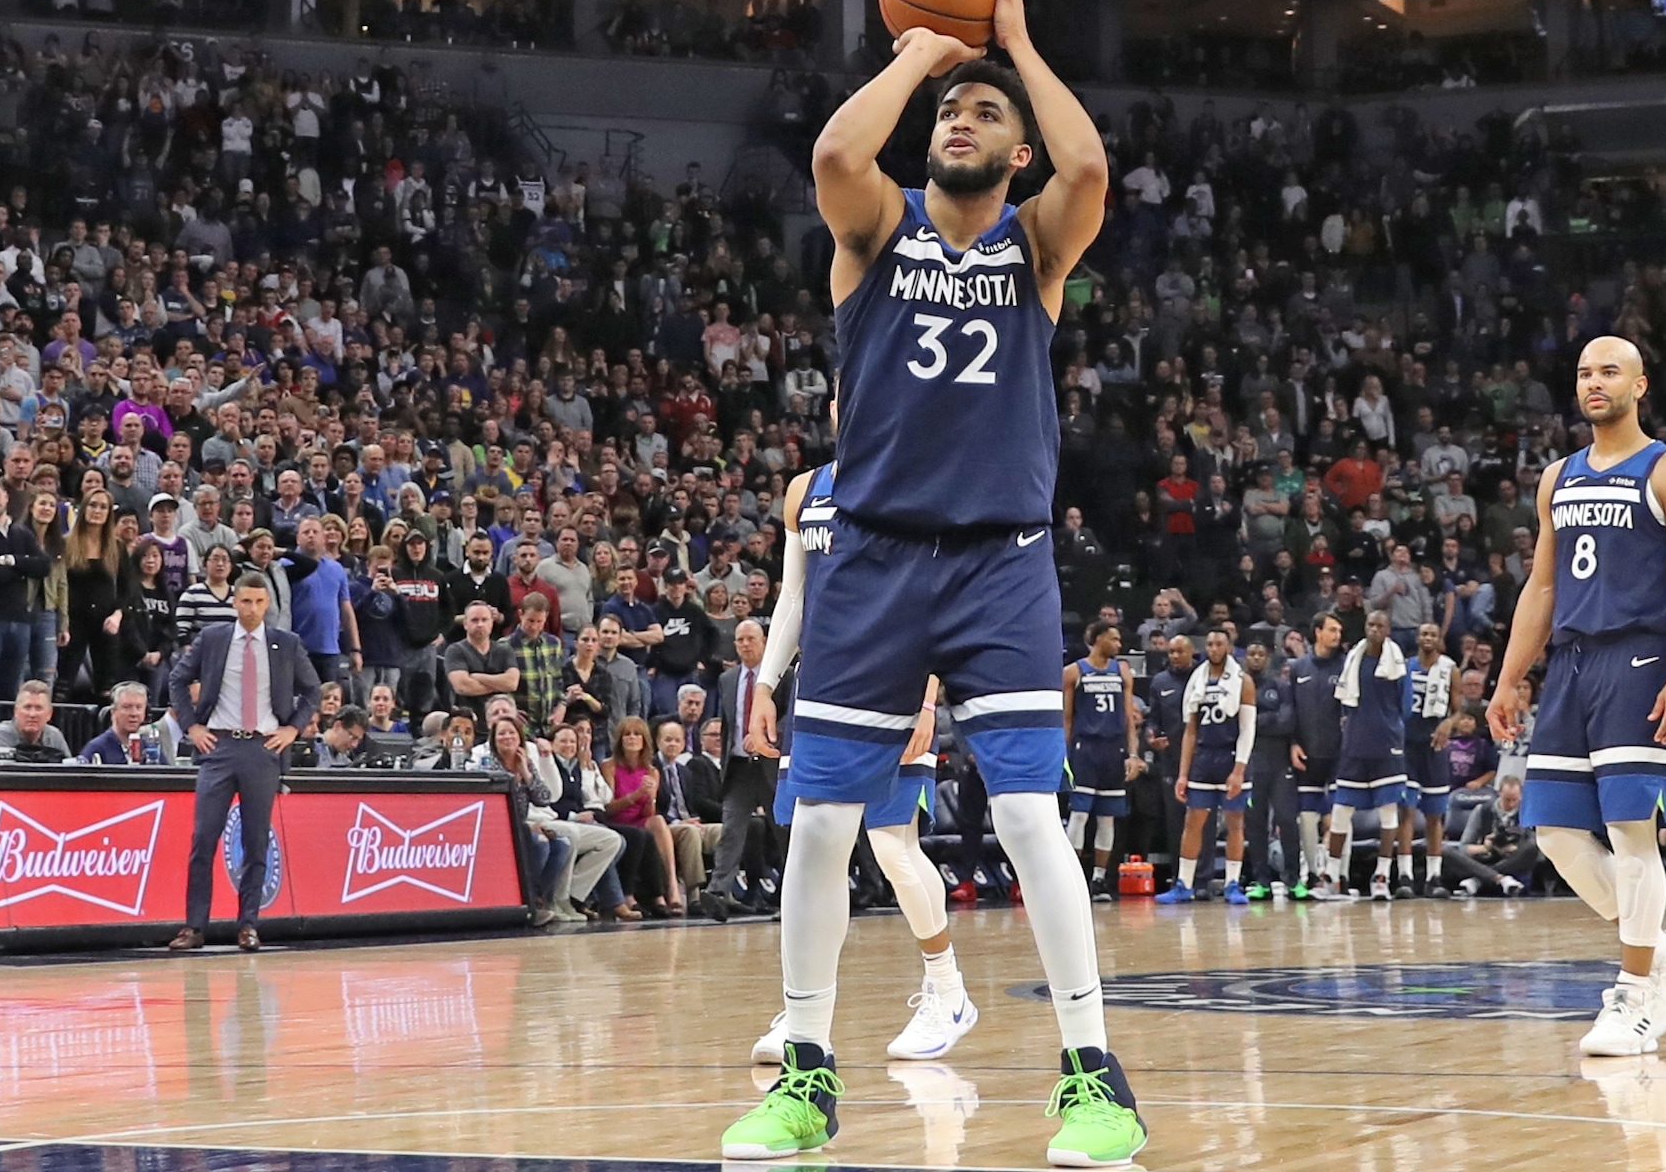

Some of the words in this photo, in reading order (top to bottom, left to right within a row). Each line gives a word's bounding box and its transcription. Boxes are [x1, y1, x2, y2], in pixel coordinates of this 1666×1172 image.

[888, 263, 1019, 310] MINNESOTA
[906, 312, 999, 385] 32
[1551, 503, 1634, 530] MINNESOTA
[1571, 533, 1598, 580] 8
[1094, 693, 1115, 713] 31
[1200, 705, 1227, 725] 20
[347, 826, 478, 876] Budweiser
